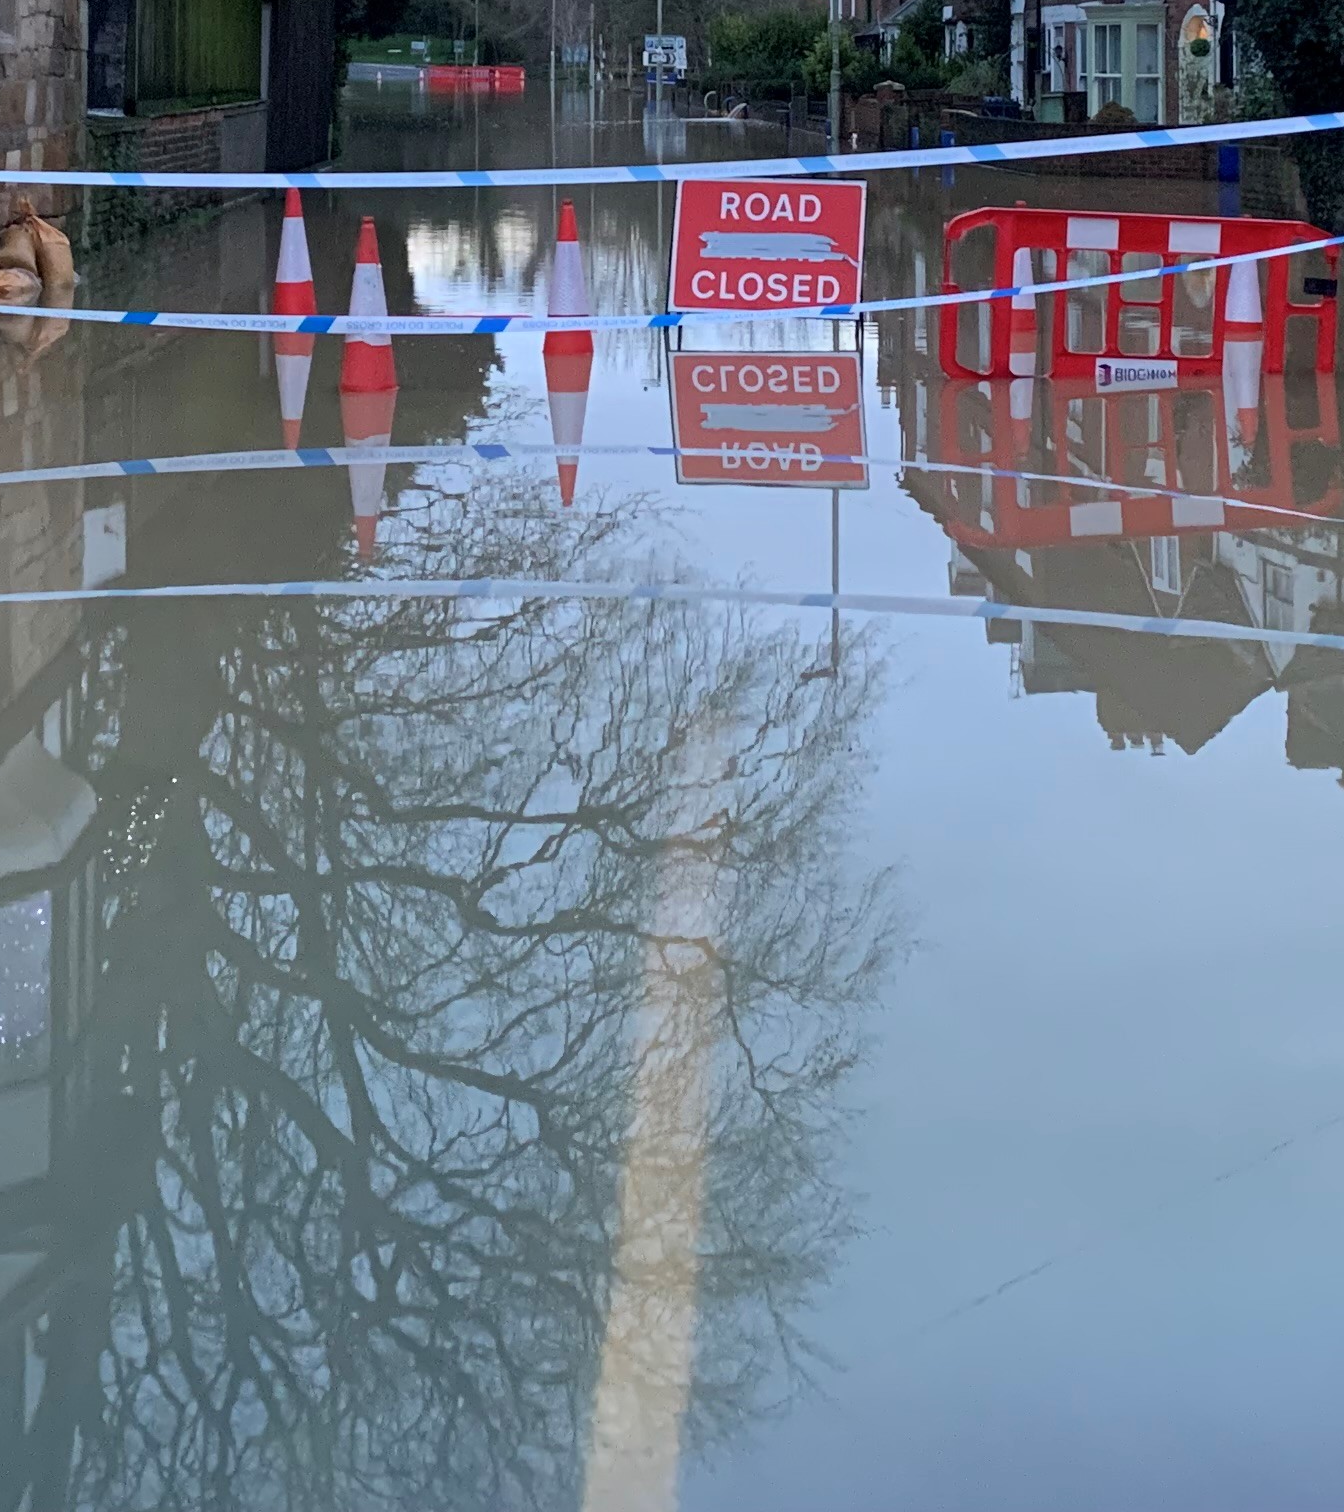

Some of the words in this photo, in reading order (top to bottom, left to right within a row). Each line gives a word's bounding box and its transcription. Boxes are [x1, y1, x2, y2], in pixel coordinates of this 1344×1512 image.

[720, 191, 822, 223] ROAD
[691, 270, 841, 304] CLOSED
[408, 321, 424, 330] DO
[427, 321, 464, 330] POLICE
